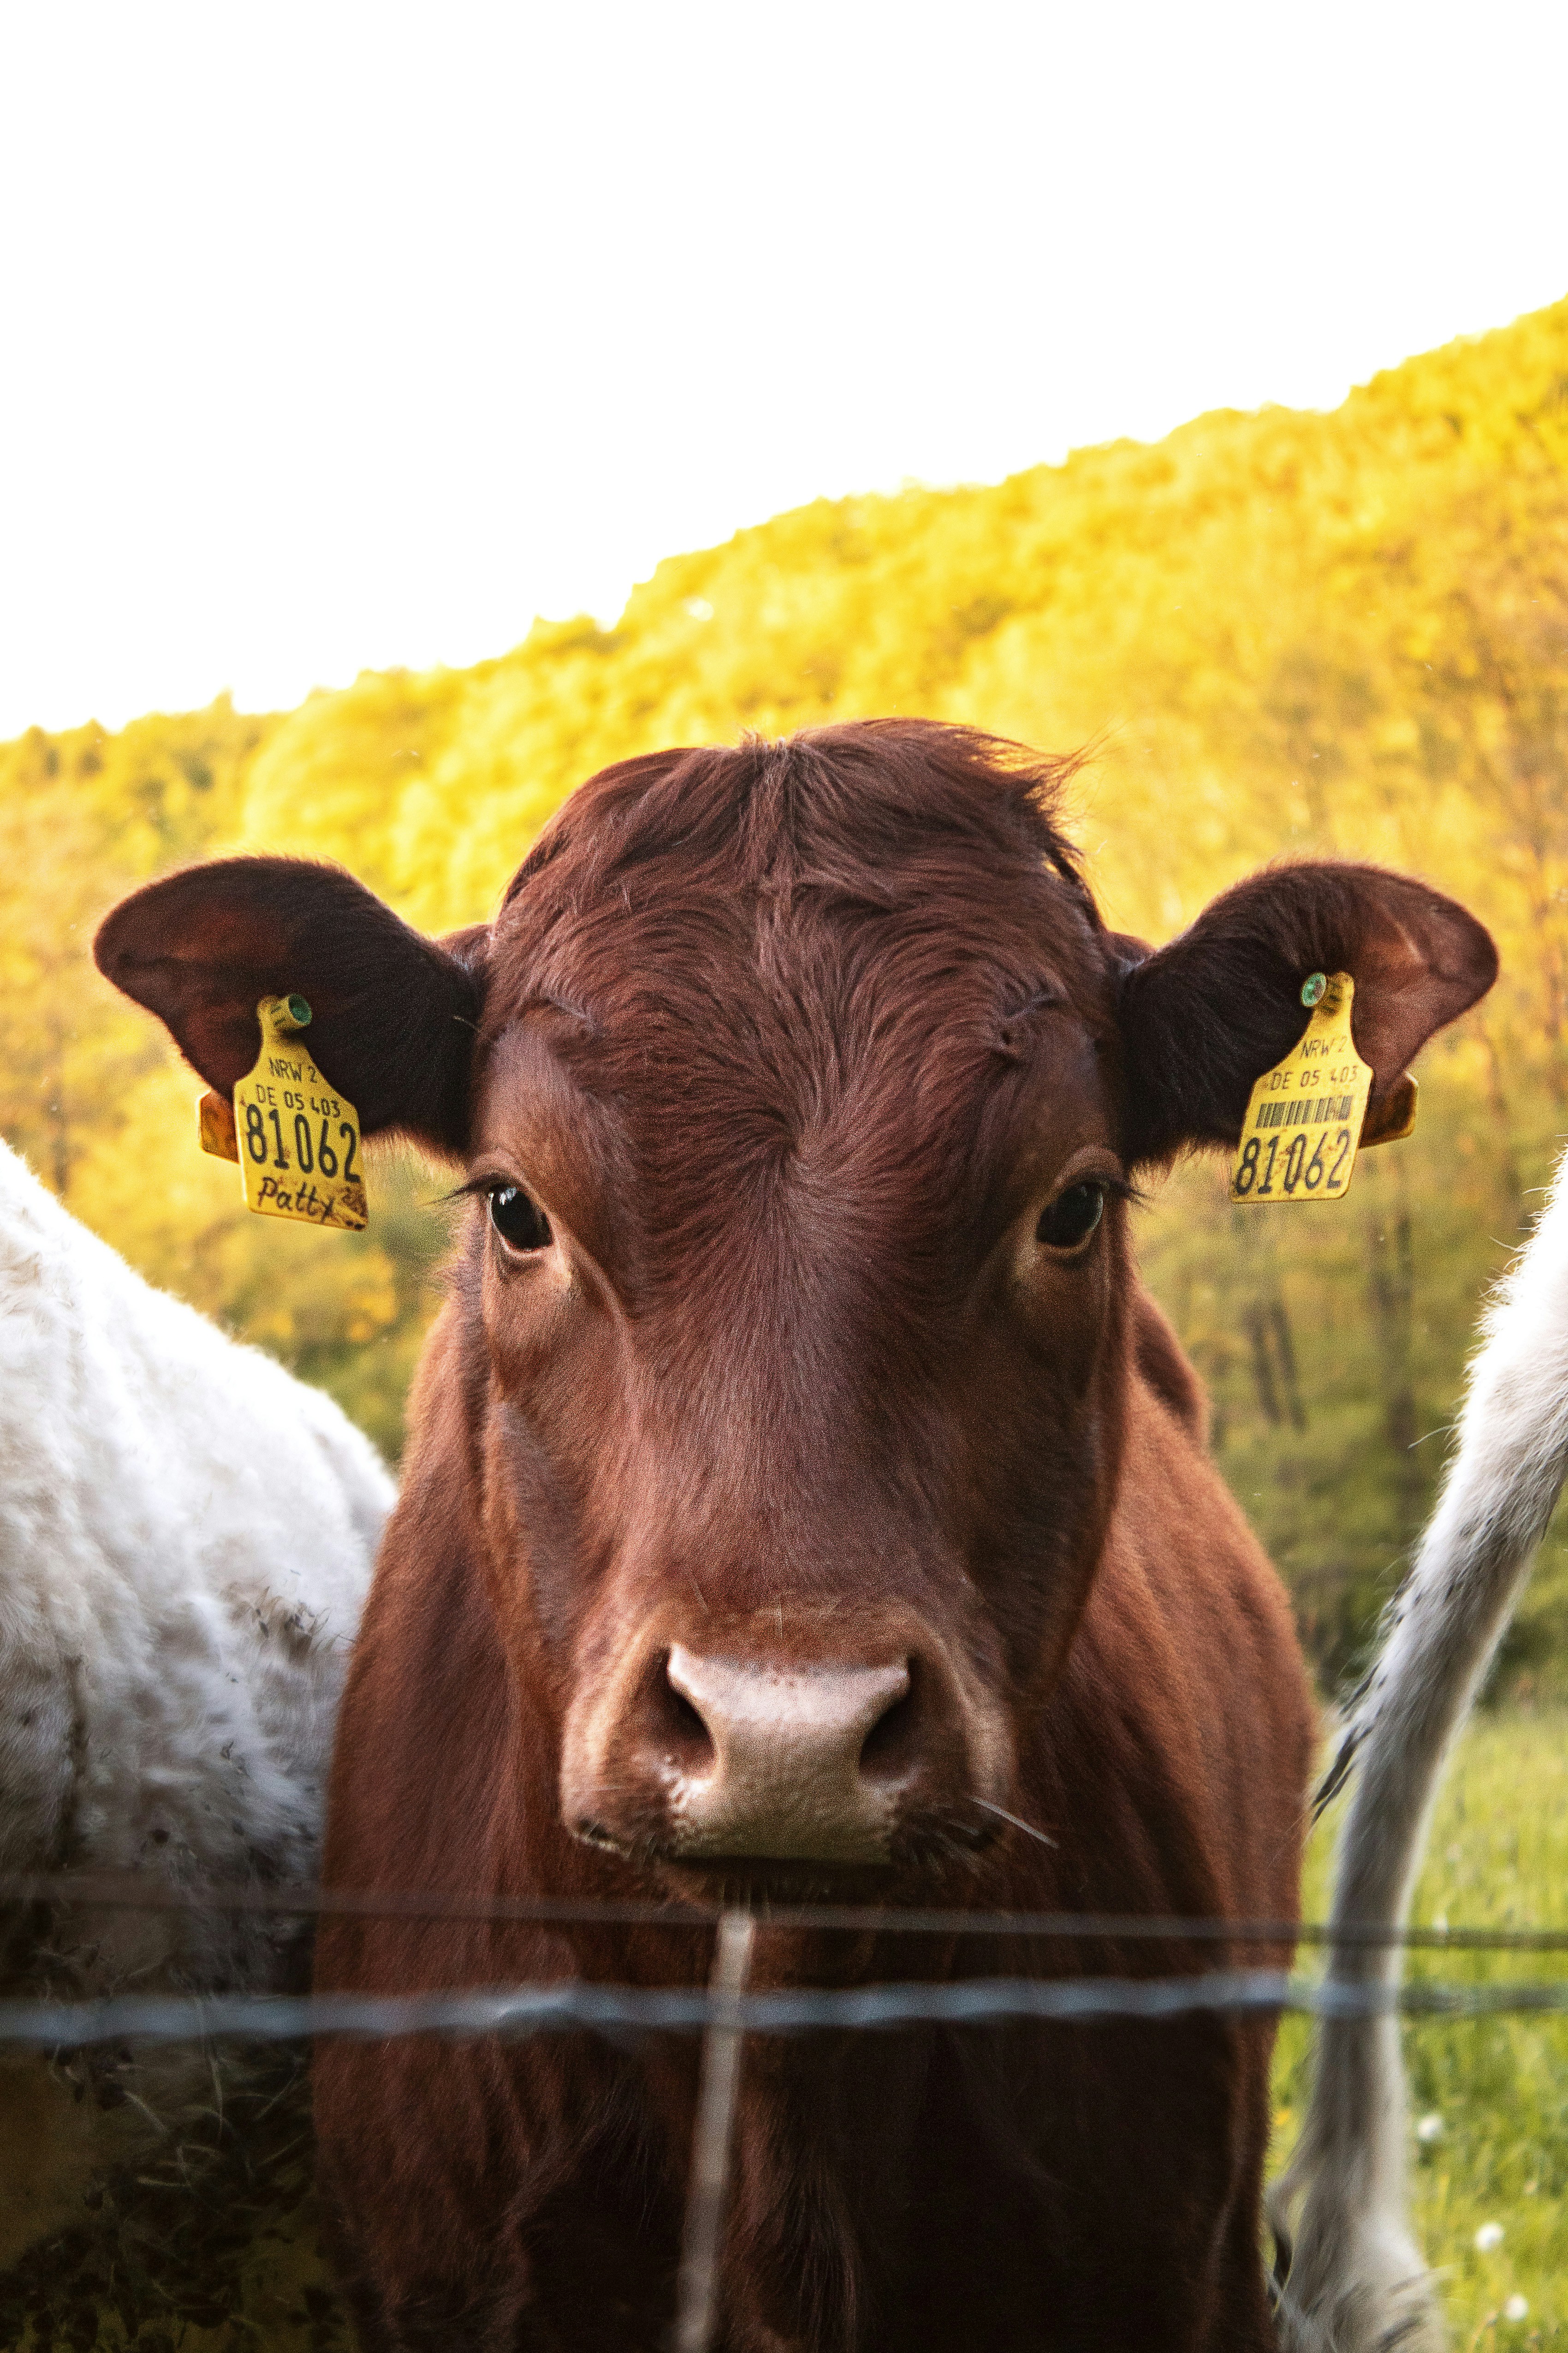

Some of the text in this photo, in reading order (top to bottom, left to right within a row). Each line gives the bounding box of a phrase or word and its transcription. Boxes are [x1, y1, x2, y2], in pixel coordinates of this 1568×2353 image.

[1300, 1039, 1332, 1058] NRW
[268, 1057, 319, 1084] NRW 2
[1271, 1070, 1292, 1090] DE
[255, 1083, 277, 1106] DE
[284, 1090, 304, 1111] 05
[246, 1103, 361, 1183] 81062
[1234, 1129, 1352, 1196] 81062
